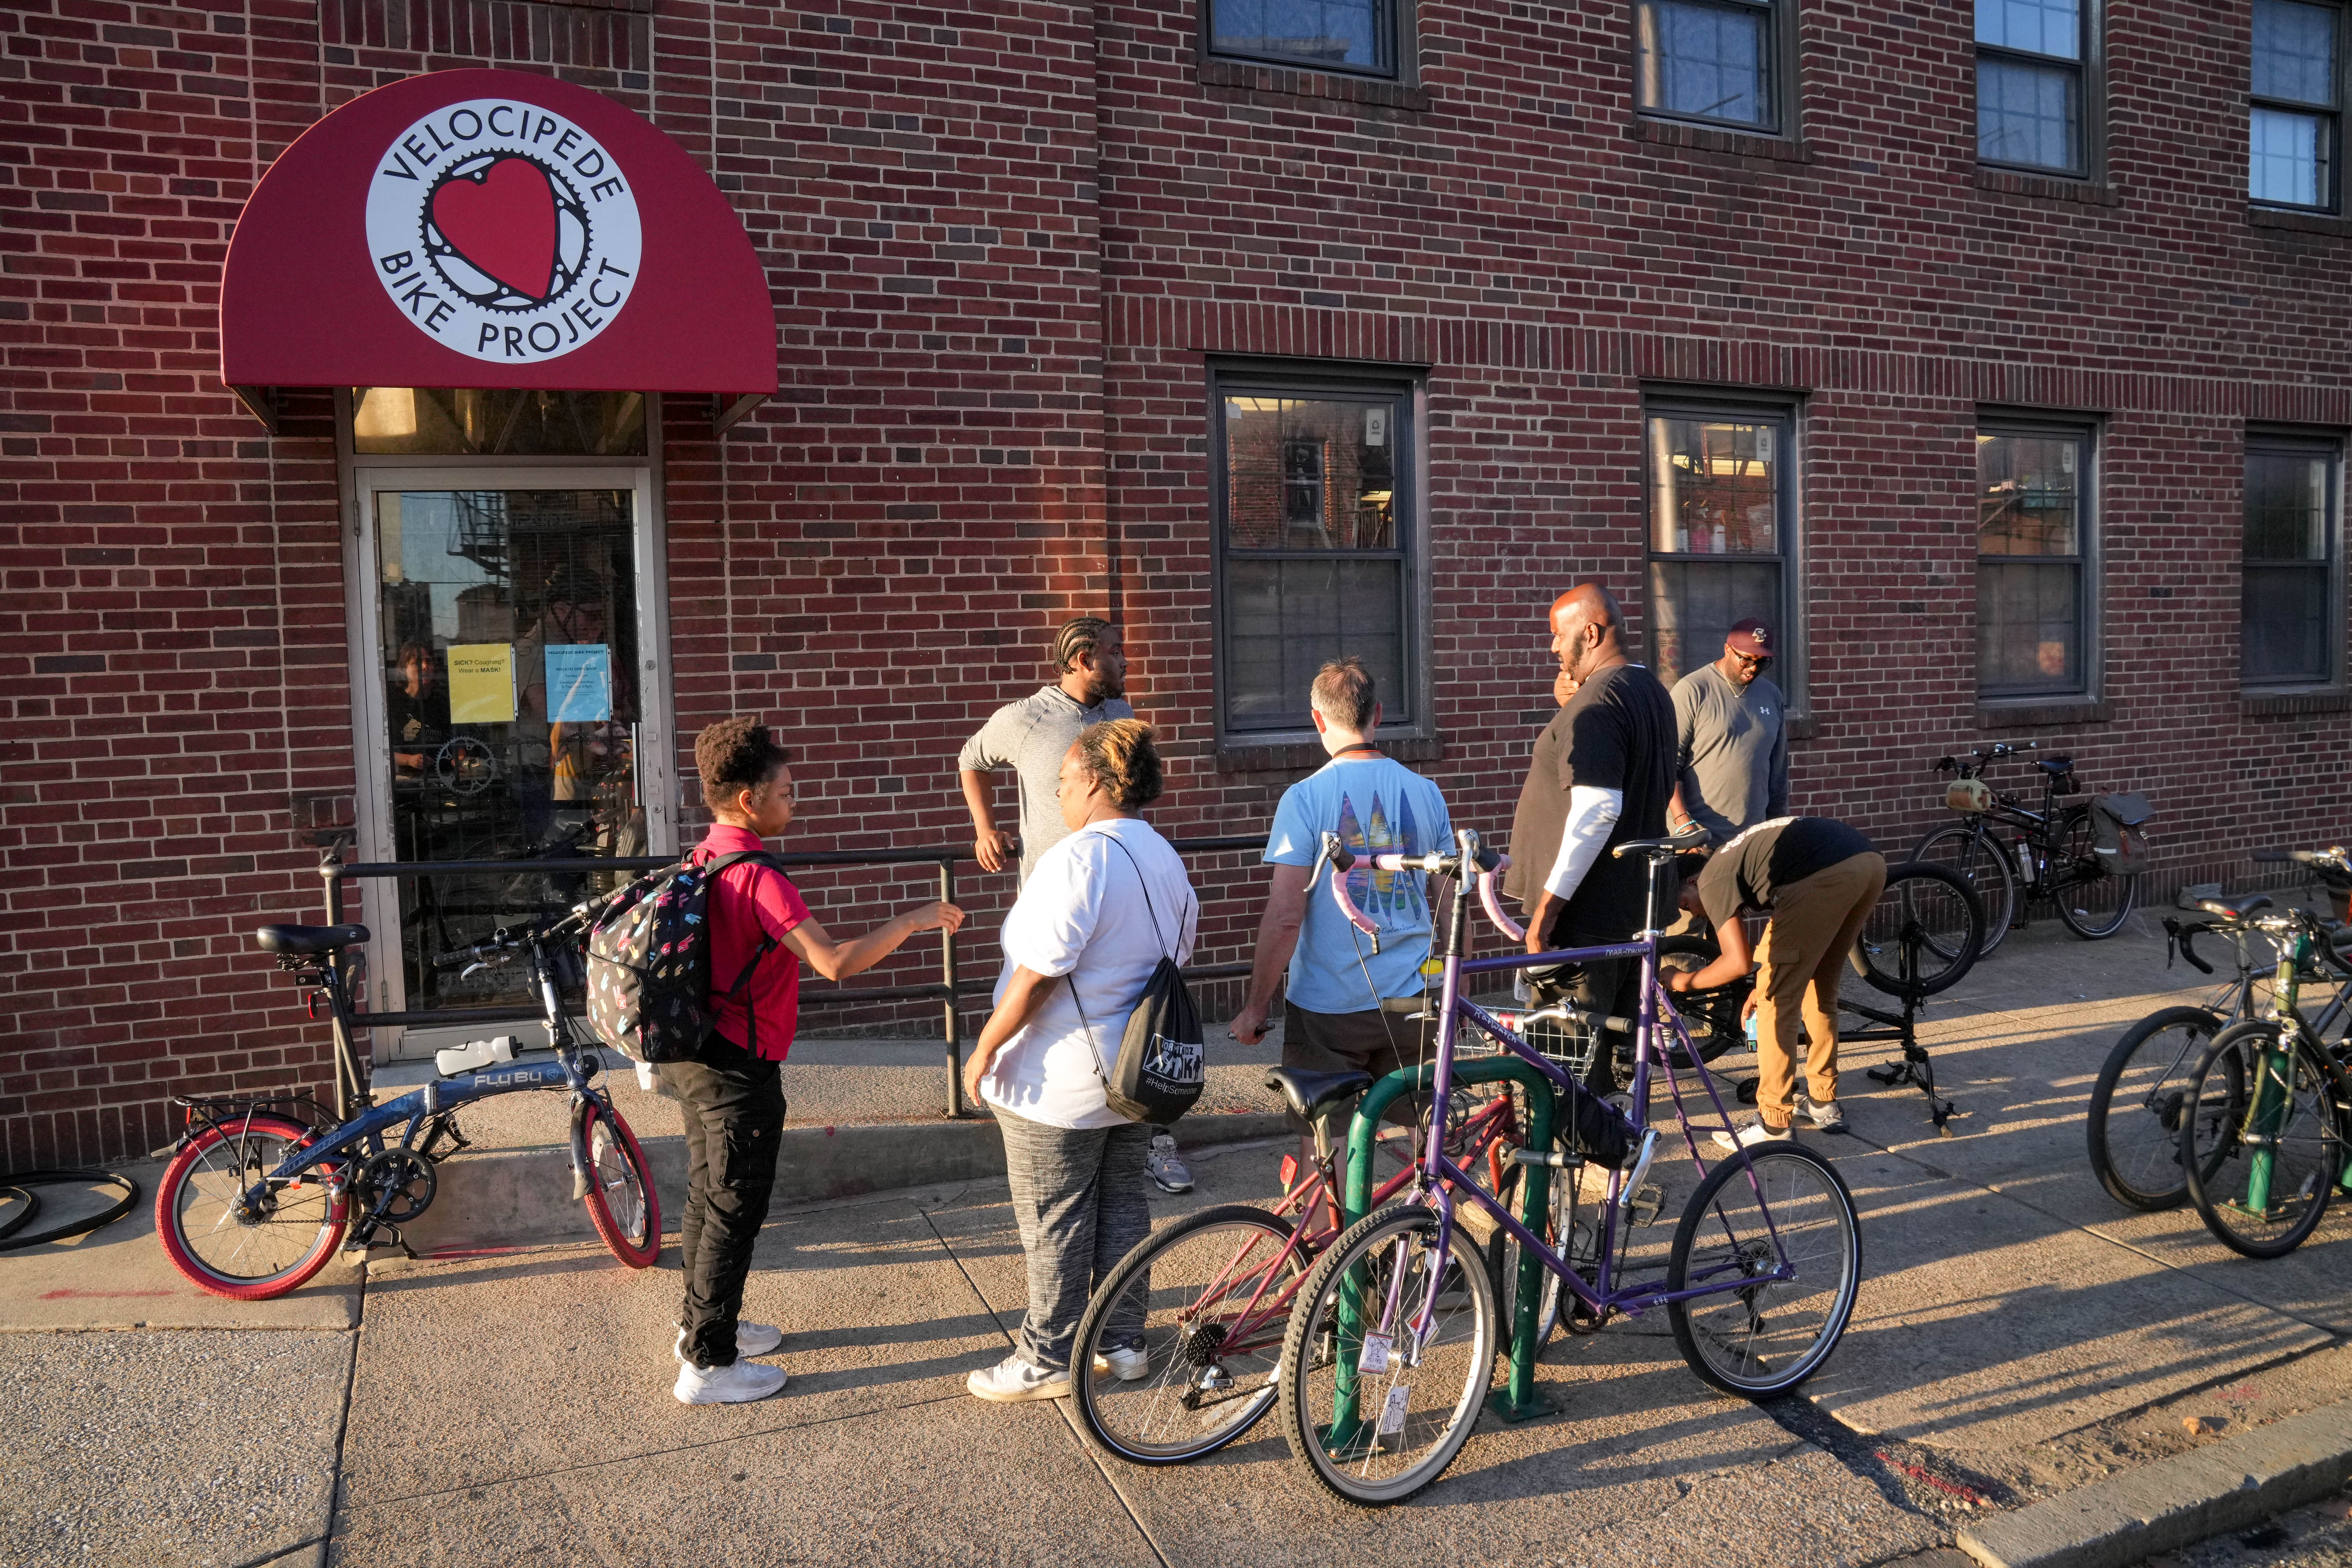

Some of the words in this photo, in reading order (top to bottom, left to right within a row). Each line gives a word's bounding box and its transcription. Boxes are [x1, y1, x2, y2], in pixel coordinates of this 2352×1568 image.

[383, 105, 624, 202] VELOCIPEDE
[380, 250, 456, 333] BIKE
[478, 257, 630, 356] PROJECT
[1605, 947, 1650, 957] MAR-MACHINE
[1146, 1076, 1197, 1095] #HelpSomeone
